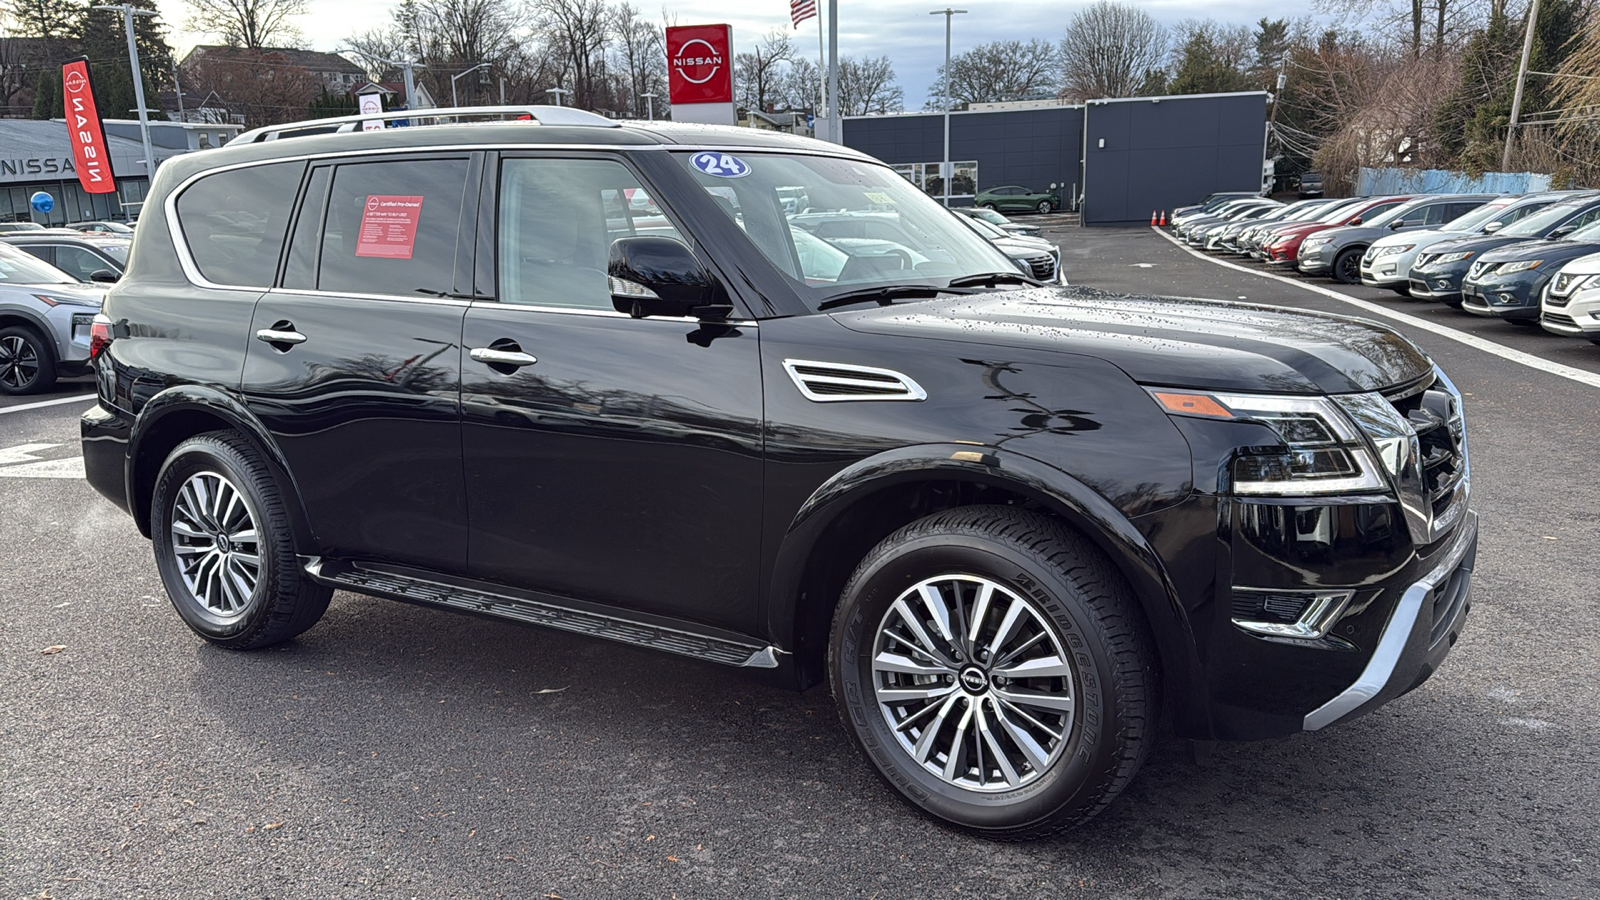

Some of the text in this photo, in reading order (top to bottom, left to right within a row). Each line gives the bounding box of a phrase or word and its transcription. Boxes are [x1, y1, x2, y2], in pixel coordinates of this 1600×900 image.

[673, 56, 722, 66] NISSAN
[1, 158, 76, 176] NISSA
[699, 154, 740, 174] 24
[1012, 573, 1099, 765] BRIDGESTONE
